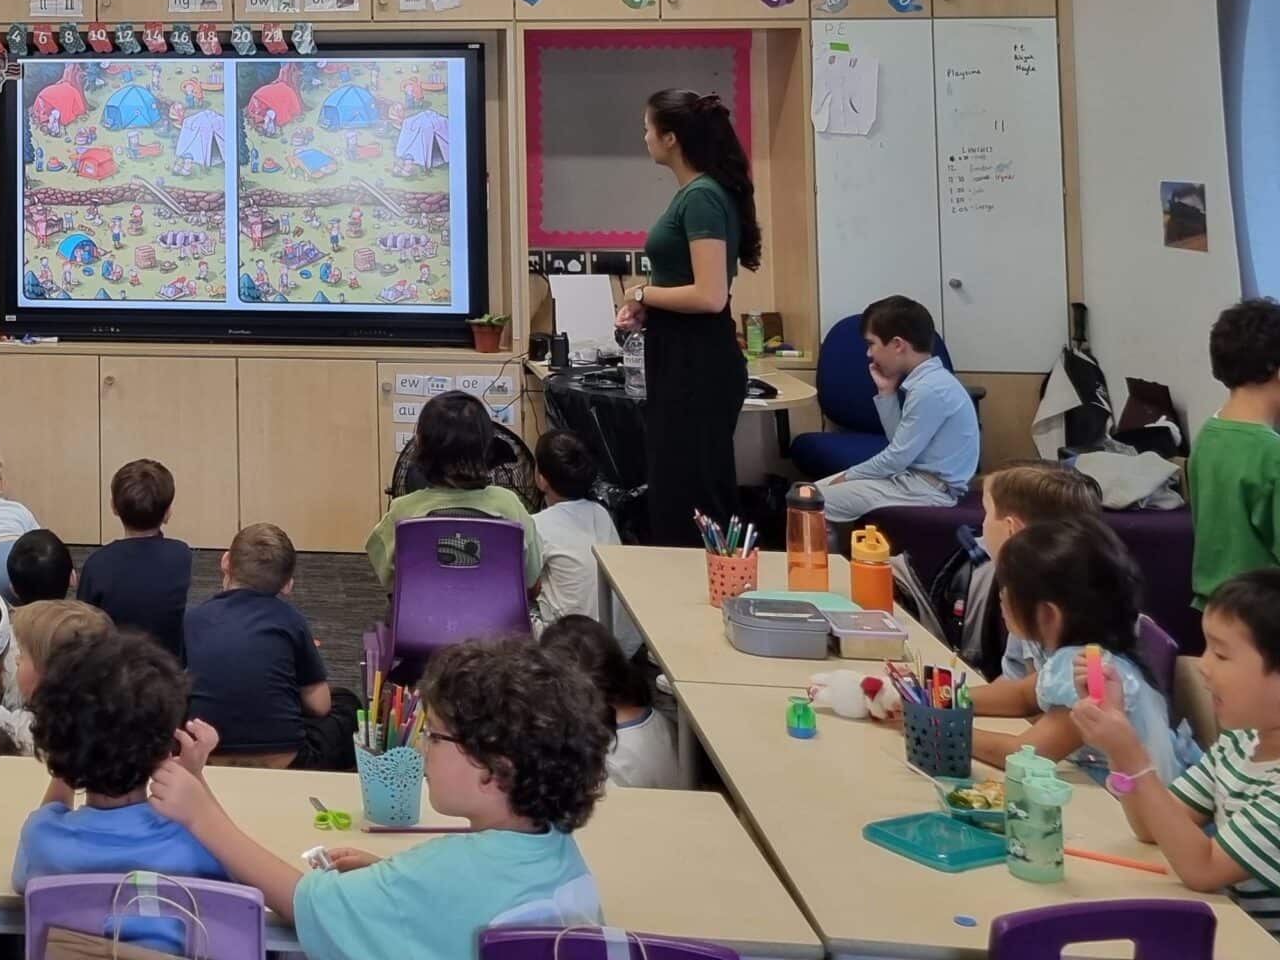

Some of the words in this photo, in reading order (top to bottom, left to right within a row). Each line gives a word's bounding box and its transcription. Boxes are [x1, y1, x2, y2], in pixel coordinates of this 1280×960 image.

[11, 30, 21, 42] 4
[38, 31, 47, 44] 6
[64, 30, 74, 43] 8
[89, 29, 106, 41] 10
[117, 30, 133, 42] 12
[145, 30, 162, 41] 14
[173, 31, 189, 42] 16
[200, 30, 216, 42] 18
[233, 31, 251, 43] 20
[400, 378, 420, 389] ew
[462, 378, 478, 389] oe
[398, 405, 415, 416] au
